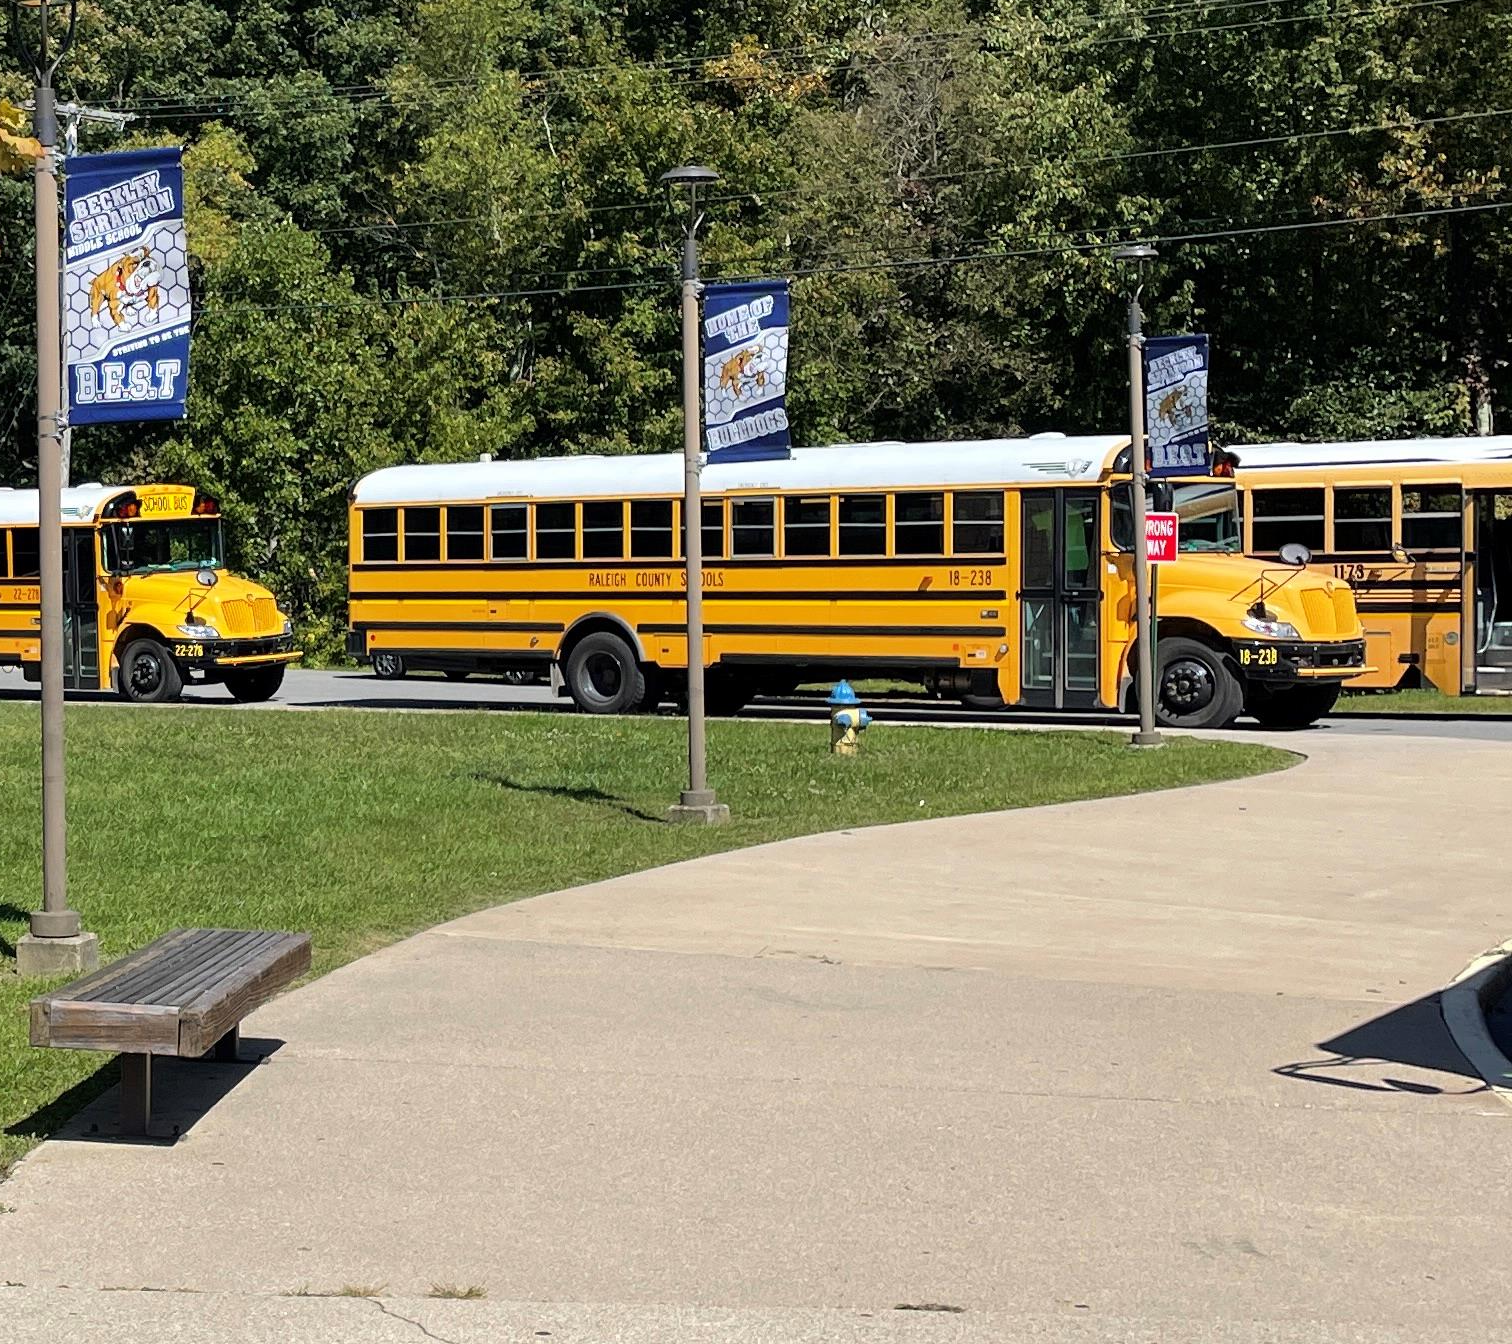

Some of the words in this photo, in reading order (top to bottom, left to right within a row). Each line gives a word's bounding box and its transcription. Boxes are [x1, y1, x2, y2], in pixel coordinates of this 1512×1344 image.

[73, 171, 159, 220] BECKLEY
[71, 188, 173, 243] STRATTON
[105, 224, 143, 246] SCHOOL
[706, 304, 750, 338] HOME
[750, 296, 773, 318] OF
[726, 318, 759, 343] THE
[707, 408, 788, 451] BULLDOGS
[143, 496, 170, 512] SCHOOL
[174, 496, 188, 510] BUS
[1146, 539, 1167, 556] WAY
[589, 572, 626, 587] RALEIGH
[635, 571, 672, 587] COUNTY
[680, 571, 724, 587] SOOLS
[949, 569, 992, 586] 18-238
[175, 644, 204, 657] 22-278
[1239, 647, 1278, 665] 18-238
